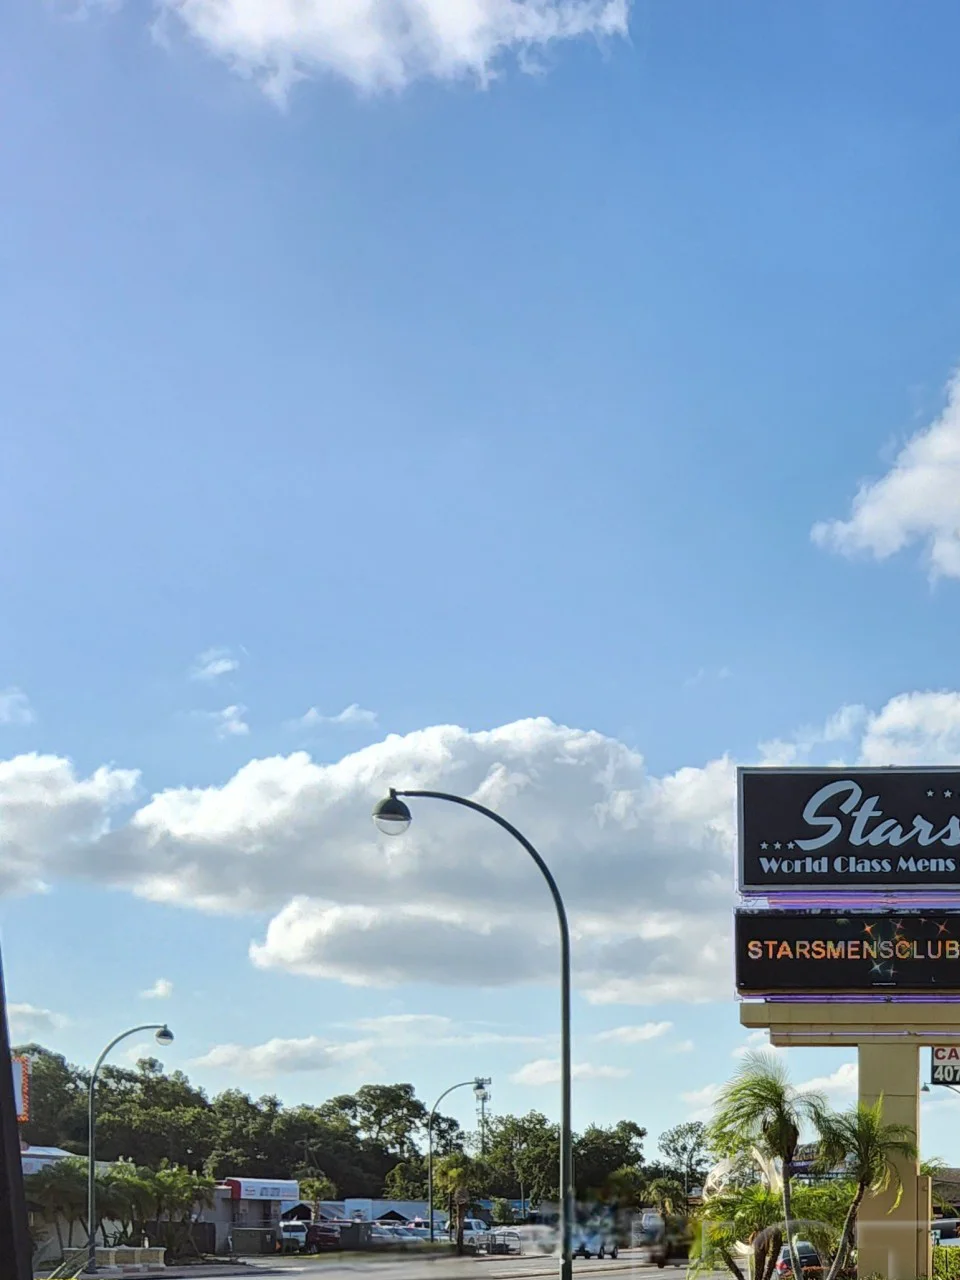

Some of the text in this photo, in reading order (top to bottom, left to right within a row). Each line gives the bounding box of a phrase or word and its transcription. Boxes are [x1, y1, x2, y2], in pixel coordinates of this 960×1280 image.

[759, 856, 828, 874] World
[834, 856, 892, 873] Class
[896, 856, 956, 873] Mens
